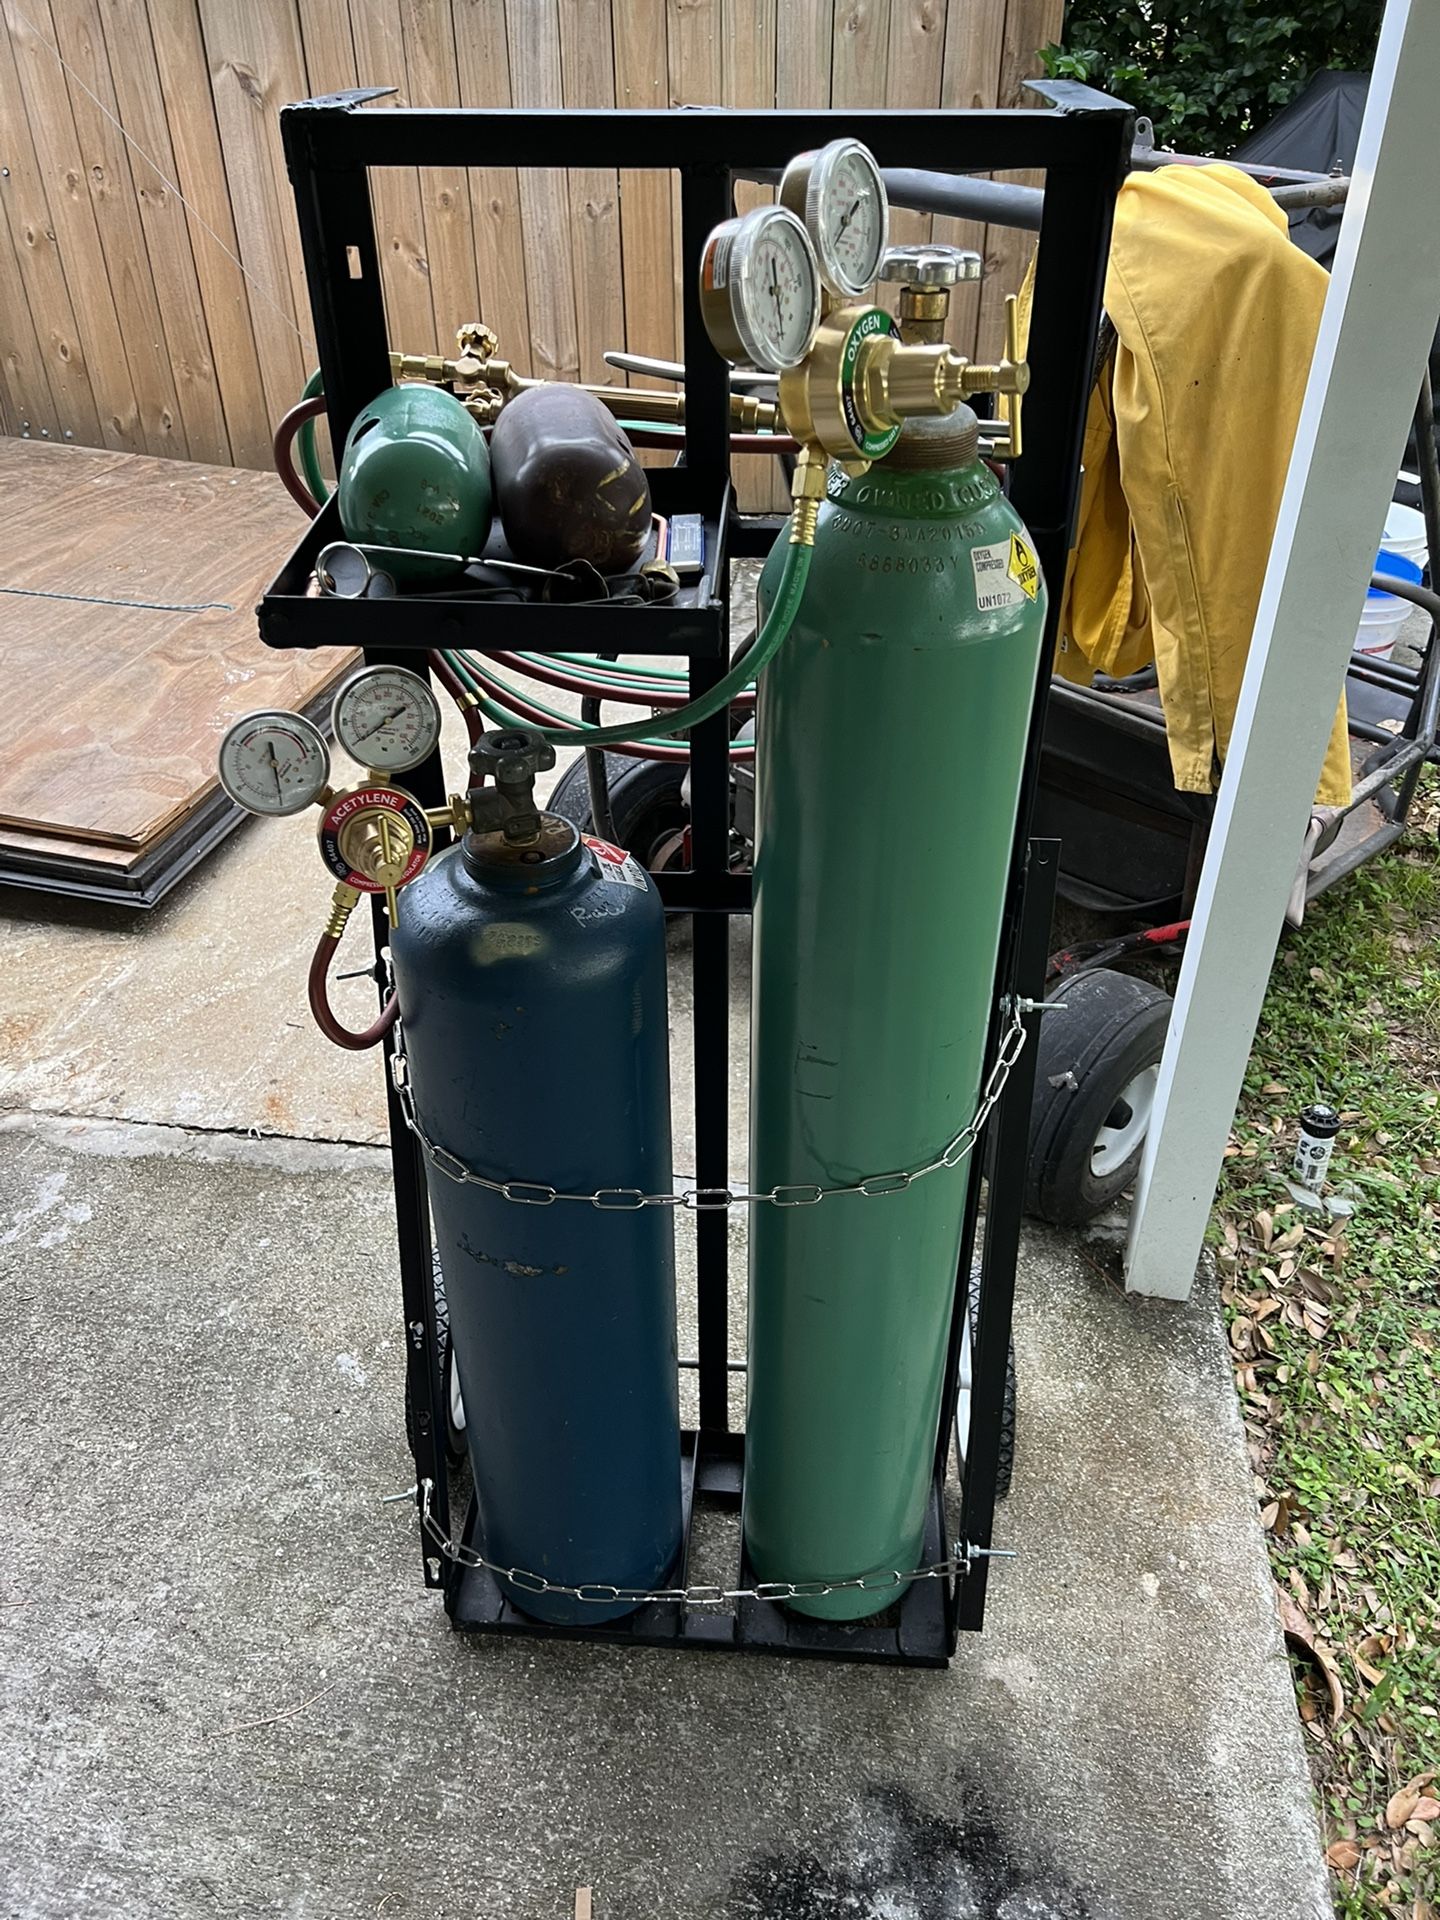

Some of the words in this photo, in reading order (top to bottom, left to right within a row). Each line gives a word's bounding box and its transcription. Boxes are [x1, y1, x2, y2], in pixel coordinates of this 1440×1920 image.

[848, 315, 880, 362] OXYGEN
[978, 592, 1011, 609] UN1072
[331, 793, 399, 825] ACETYLENE
